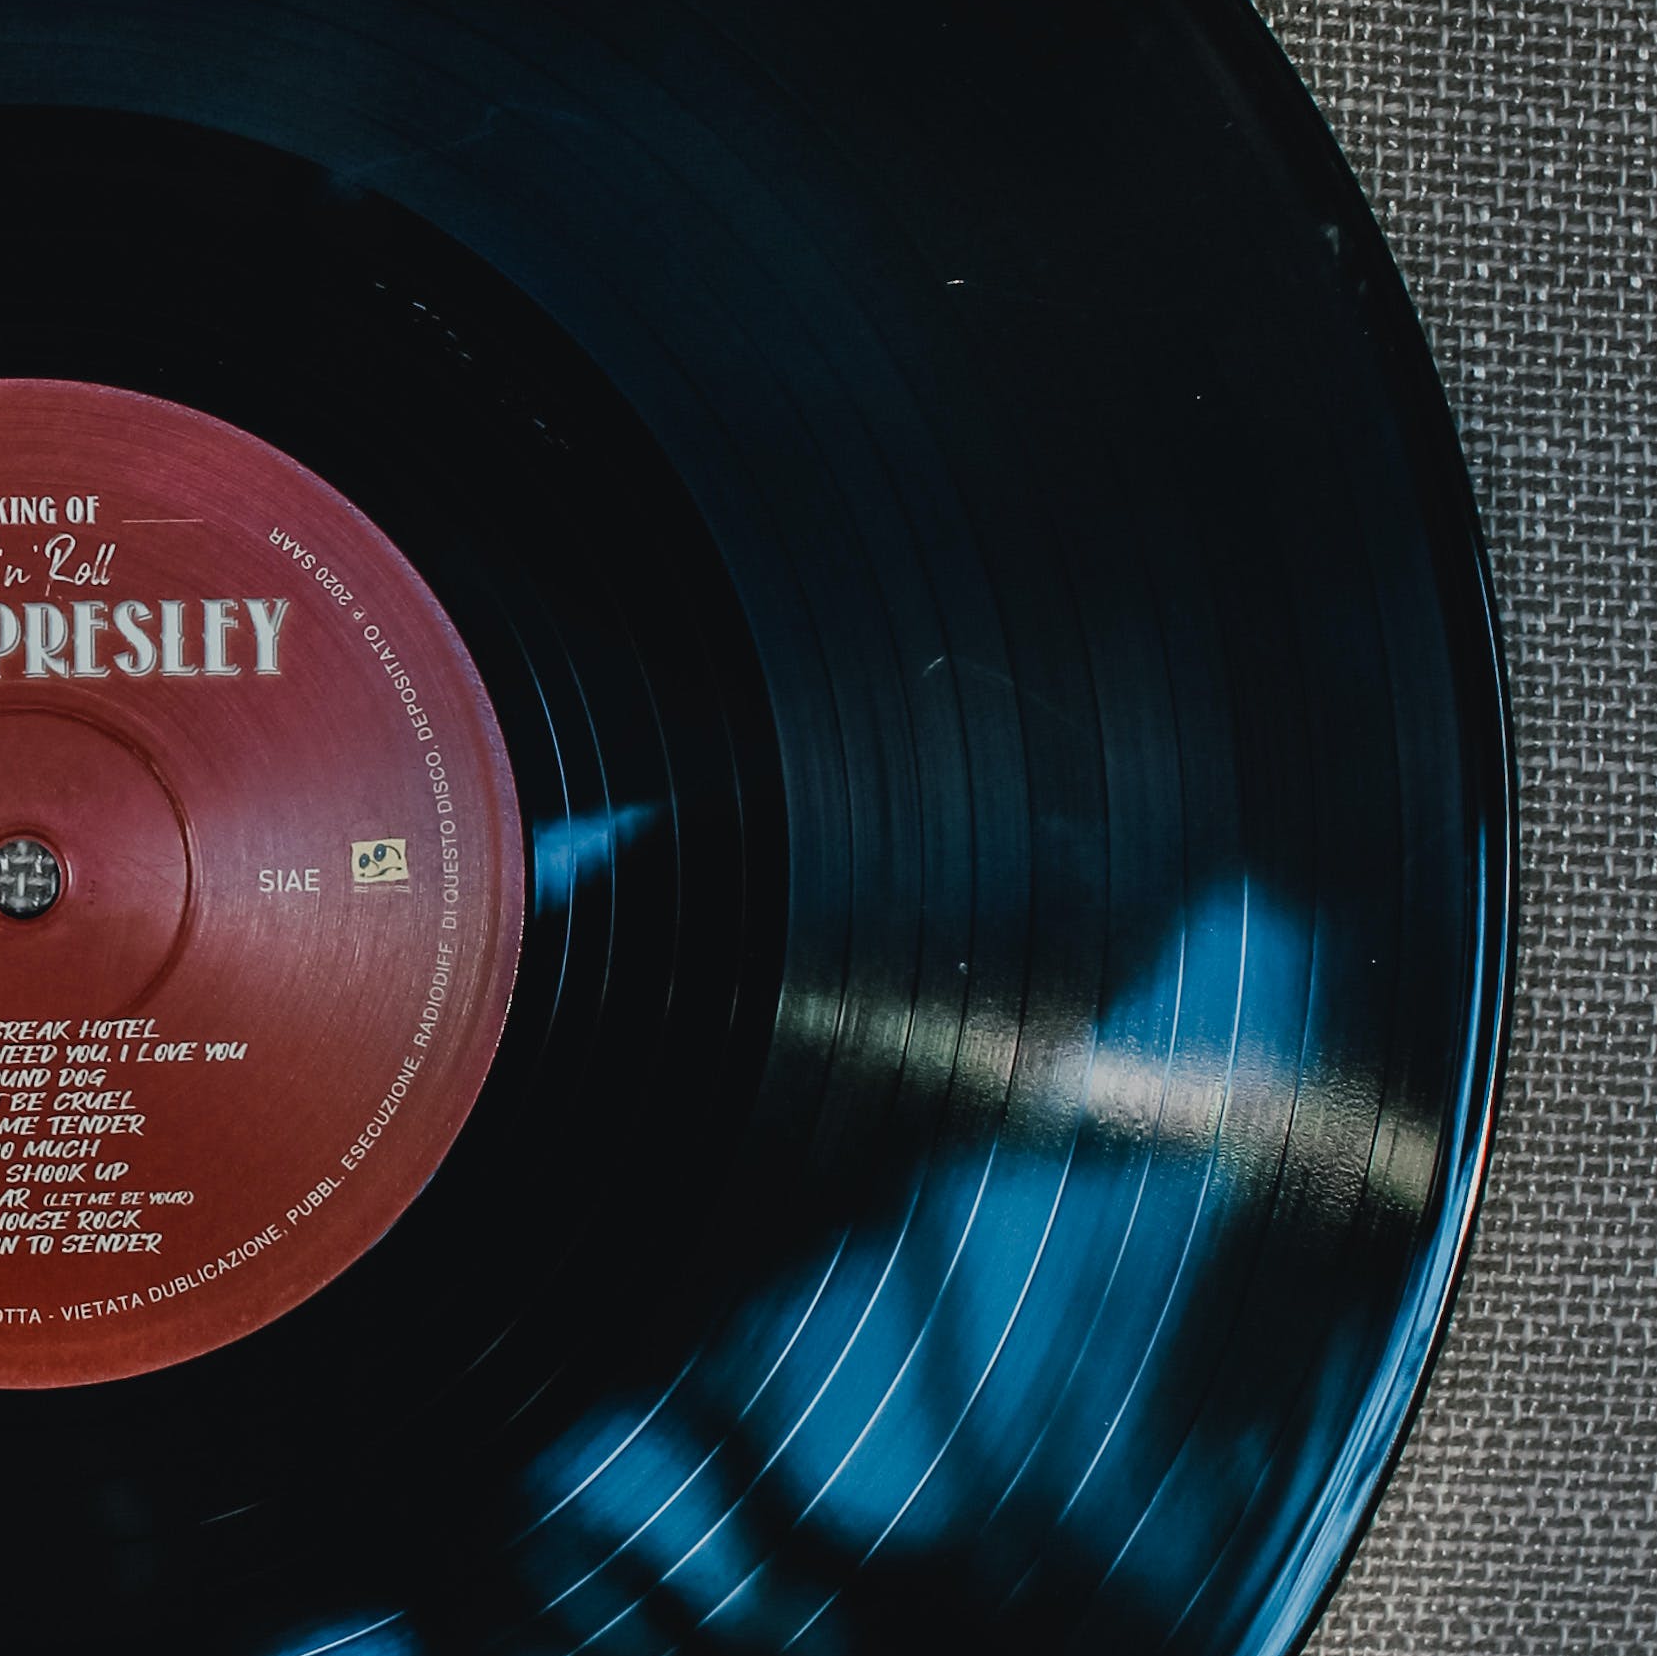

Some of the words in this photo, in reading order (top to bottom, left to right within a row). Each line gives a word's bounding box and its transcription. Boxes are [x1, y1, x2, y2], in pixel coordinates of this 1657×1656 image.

[65, 494, 101, 525] OF
[268, 526, 317, 570] SAAR
[44, 533, 116, 597] Roll
[314, 566, 354, 606] 2020
[363, 624, 434, 742] DEPOSITATO
[440, 819, 459, 903] QUESTO
[258, 868, 321, 893] SIAE
[441, 911, 457, 930] DI
[79, 1019, 158, 1039] HOTEL
[120, 1045, 127, 1062] I
[137, 1043, 197, 1061] LOVE
[205, 1041, 247, 1060] YOU
[58, 1068, 105, 1087] DOG
[10, 1093, 45, 1111] BE
[53, 1090, 135, 1113] CRUEL
[46, 1115, 145, 1136] TENDER
[22, 1140, 101, 1159] MUCH
[5, 1163, 85, 1183] SHOOK
[95, 1163, 129, 1182] UP
[42, 1195, 84, 1207] (LET
[87, 1193, 115, 1207] ME
[120, 1193, 143, 1205] BE
[149, 1191, 194, 1206] YOUR)
[77, 1210, 141, 1231] ROCK
[26, 1236, 53, 1255] TO
[61, 1234, 163, 1255] SENDER
[147, 1223, 289, 1303] DUBLICAZIONE,
[60, 1292, 145, 1322] VIETATA
